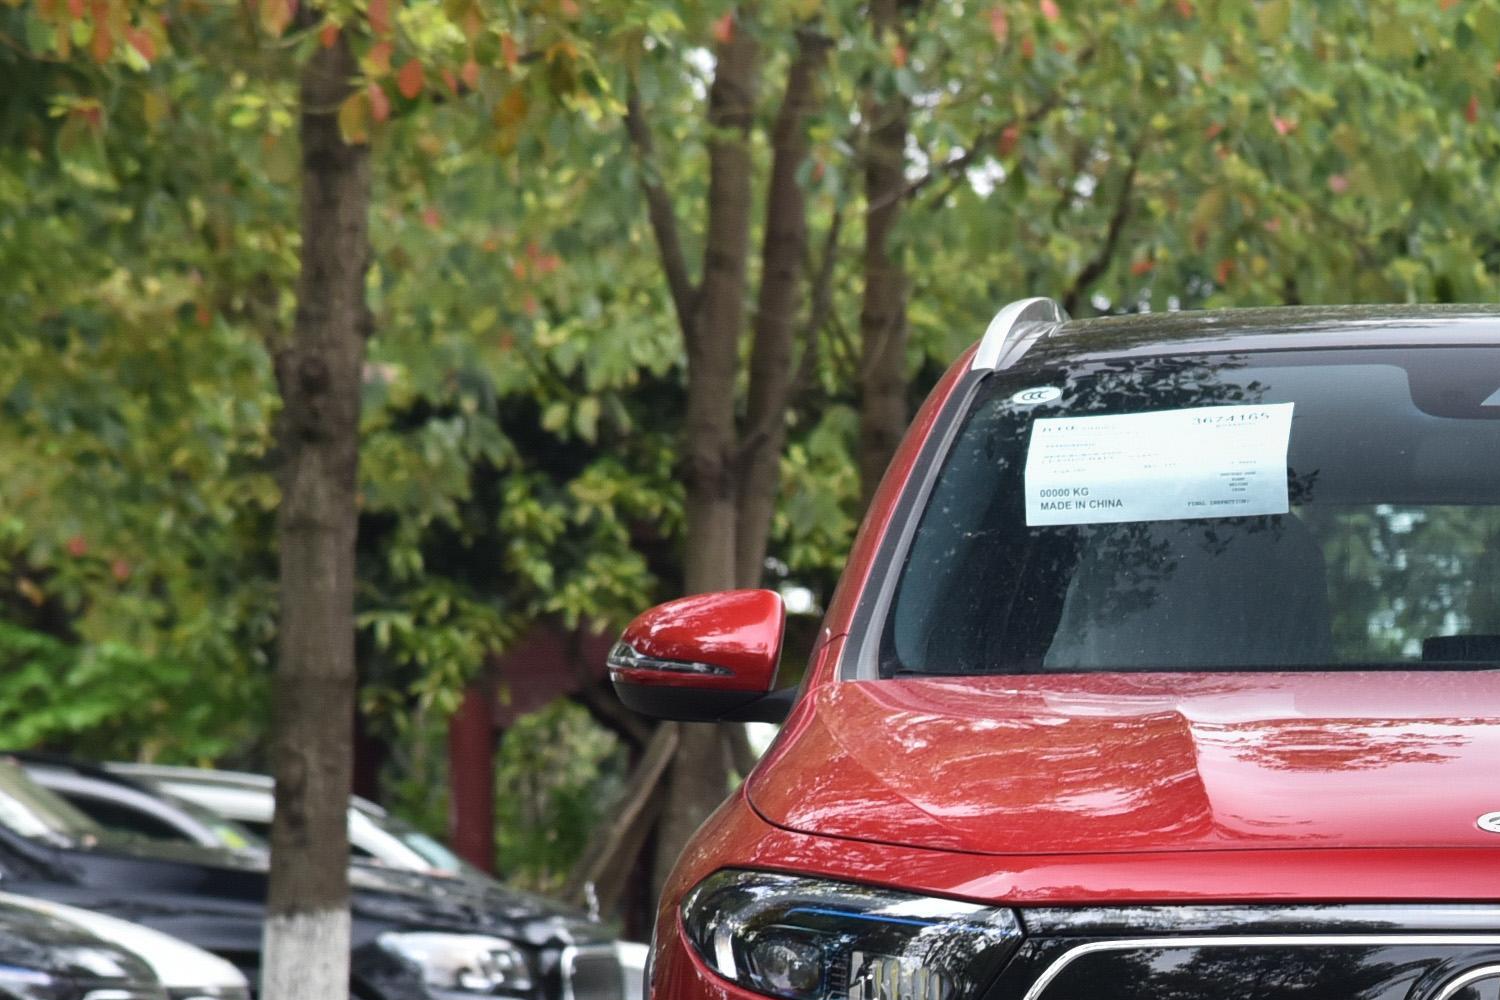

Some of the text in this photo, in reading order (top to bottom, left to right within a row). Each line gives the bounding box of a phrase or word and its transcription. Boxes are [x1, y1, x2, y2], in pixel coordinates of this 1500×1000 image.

[1039, 487, 1089, 498] 00000 KG
[1040, 499, 1123, 511] MADE IN CHINA
